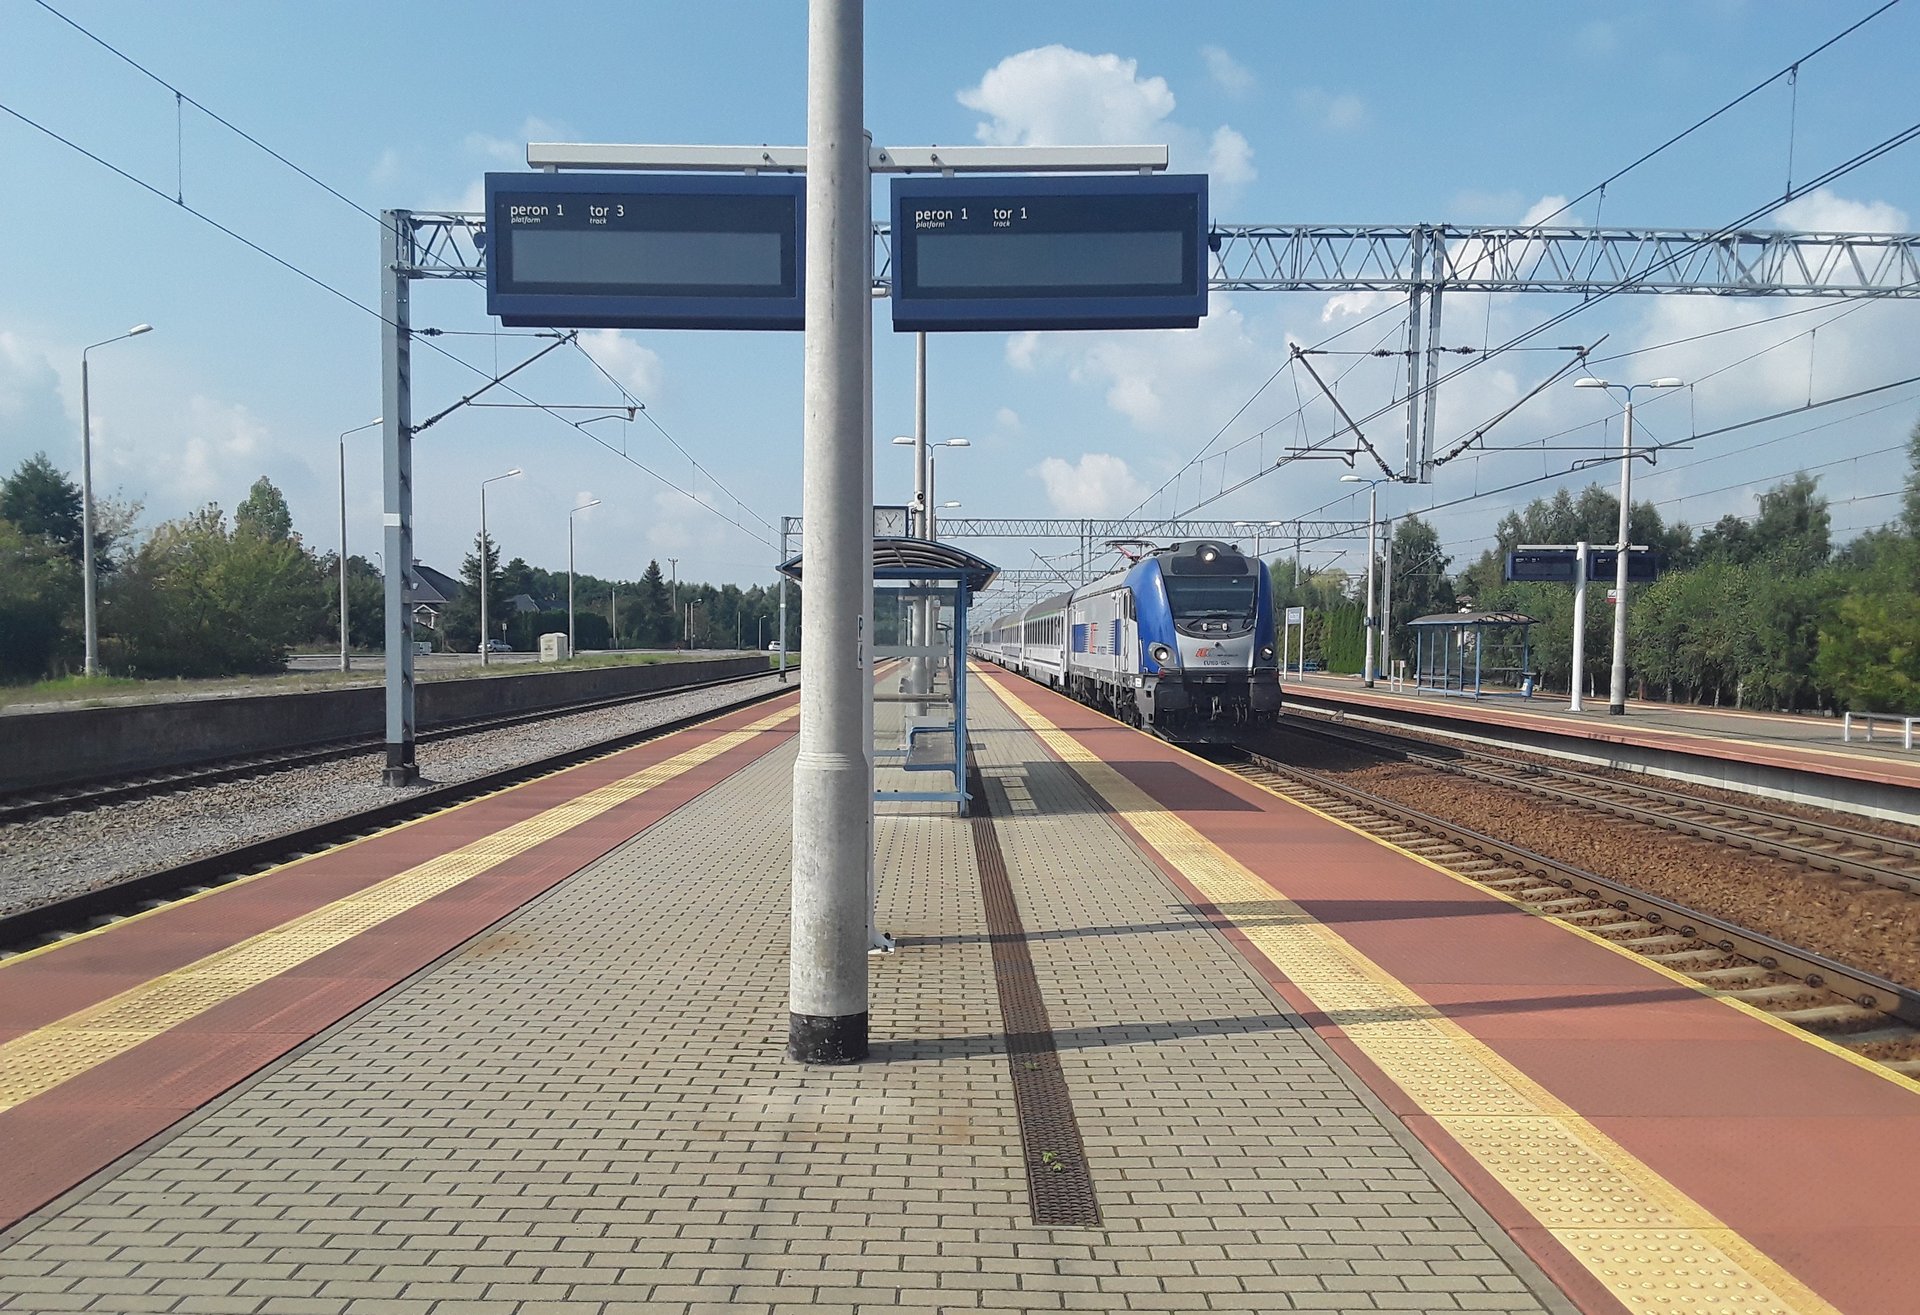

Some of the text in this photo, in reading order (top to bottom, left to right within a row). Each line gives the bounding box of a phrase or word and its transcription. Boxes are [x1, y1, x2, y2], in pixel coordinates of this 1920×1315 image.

[510, 204, 625, 217] peron 1 tor 3
[915, 207, 1028, 222] peron 1 tor 1
[511, 217, 541, 225] platform
[916, 221, 945, 229] platform
